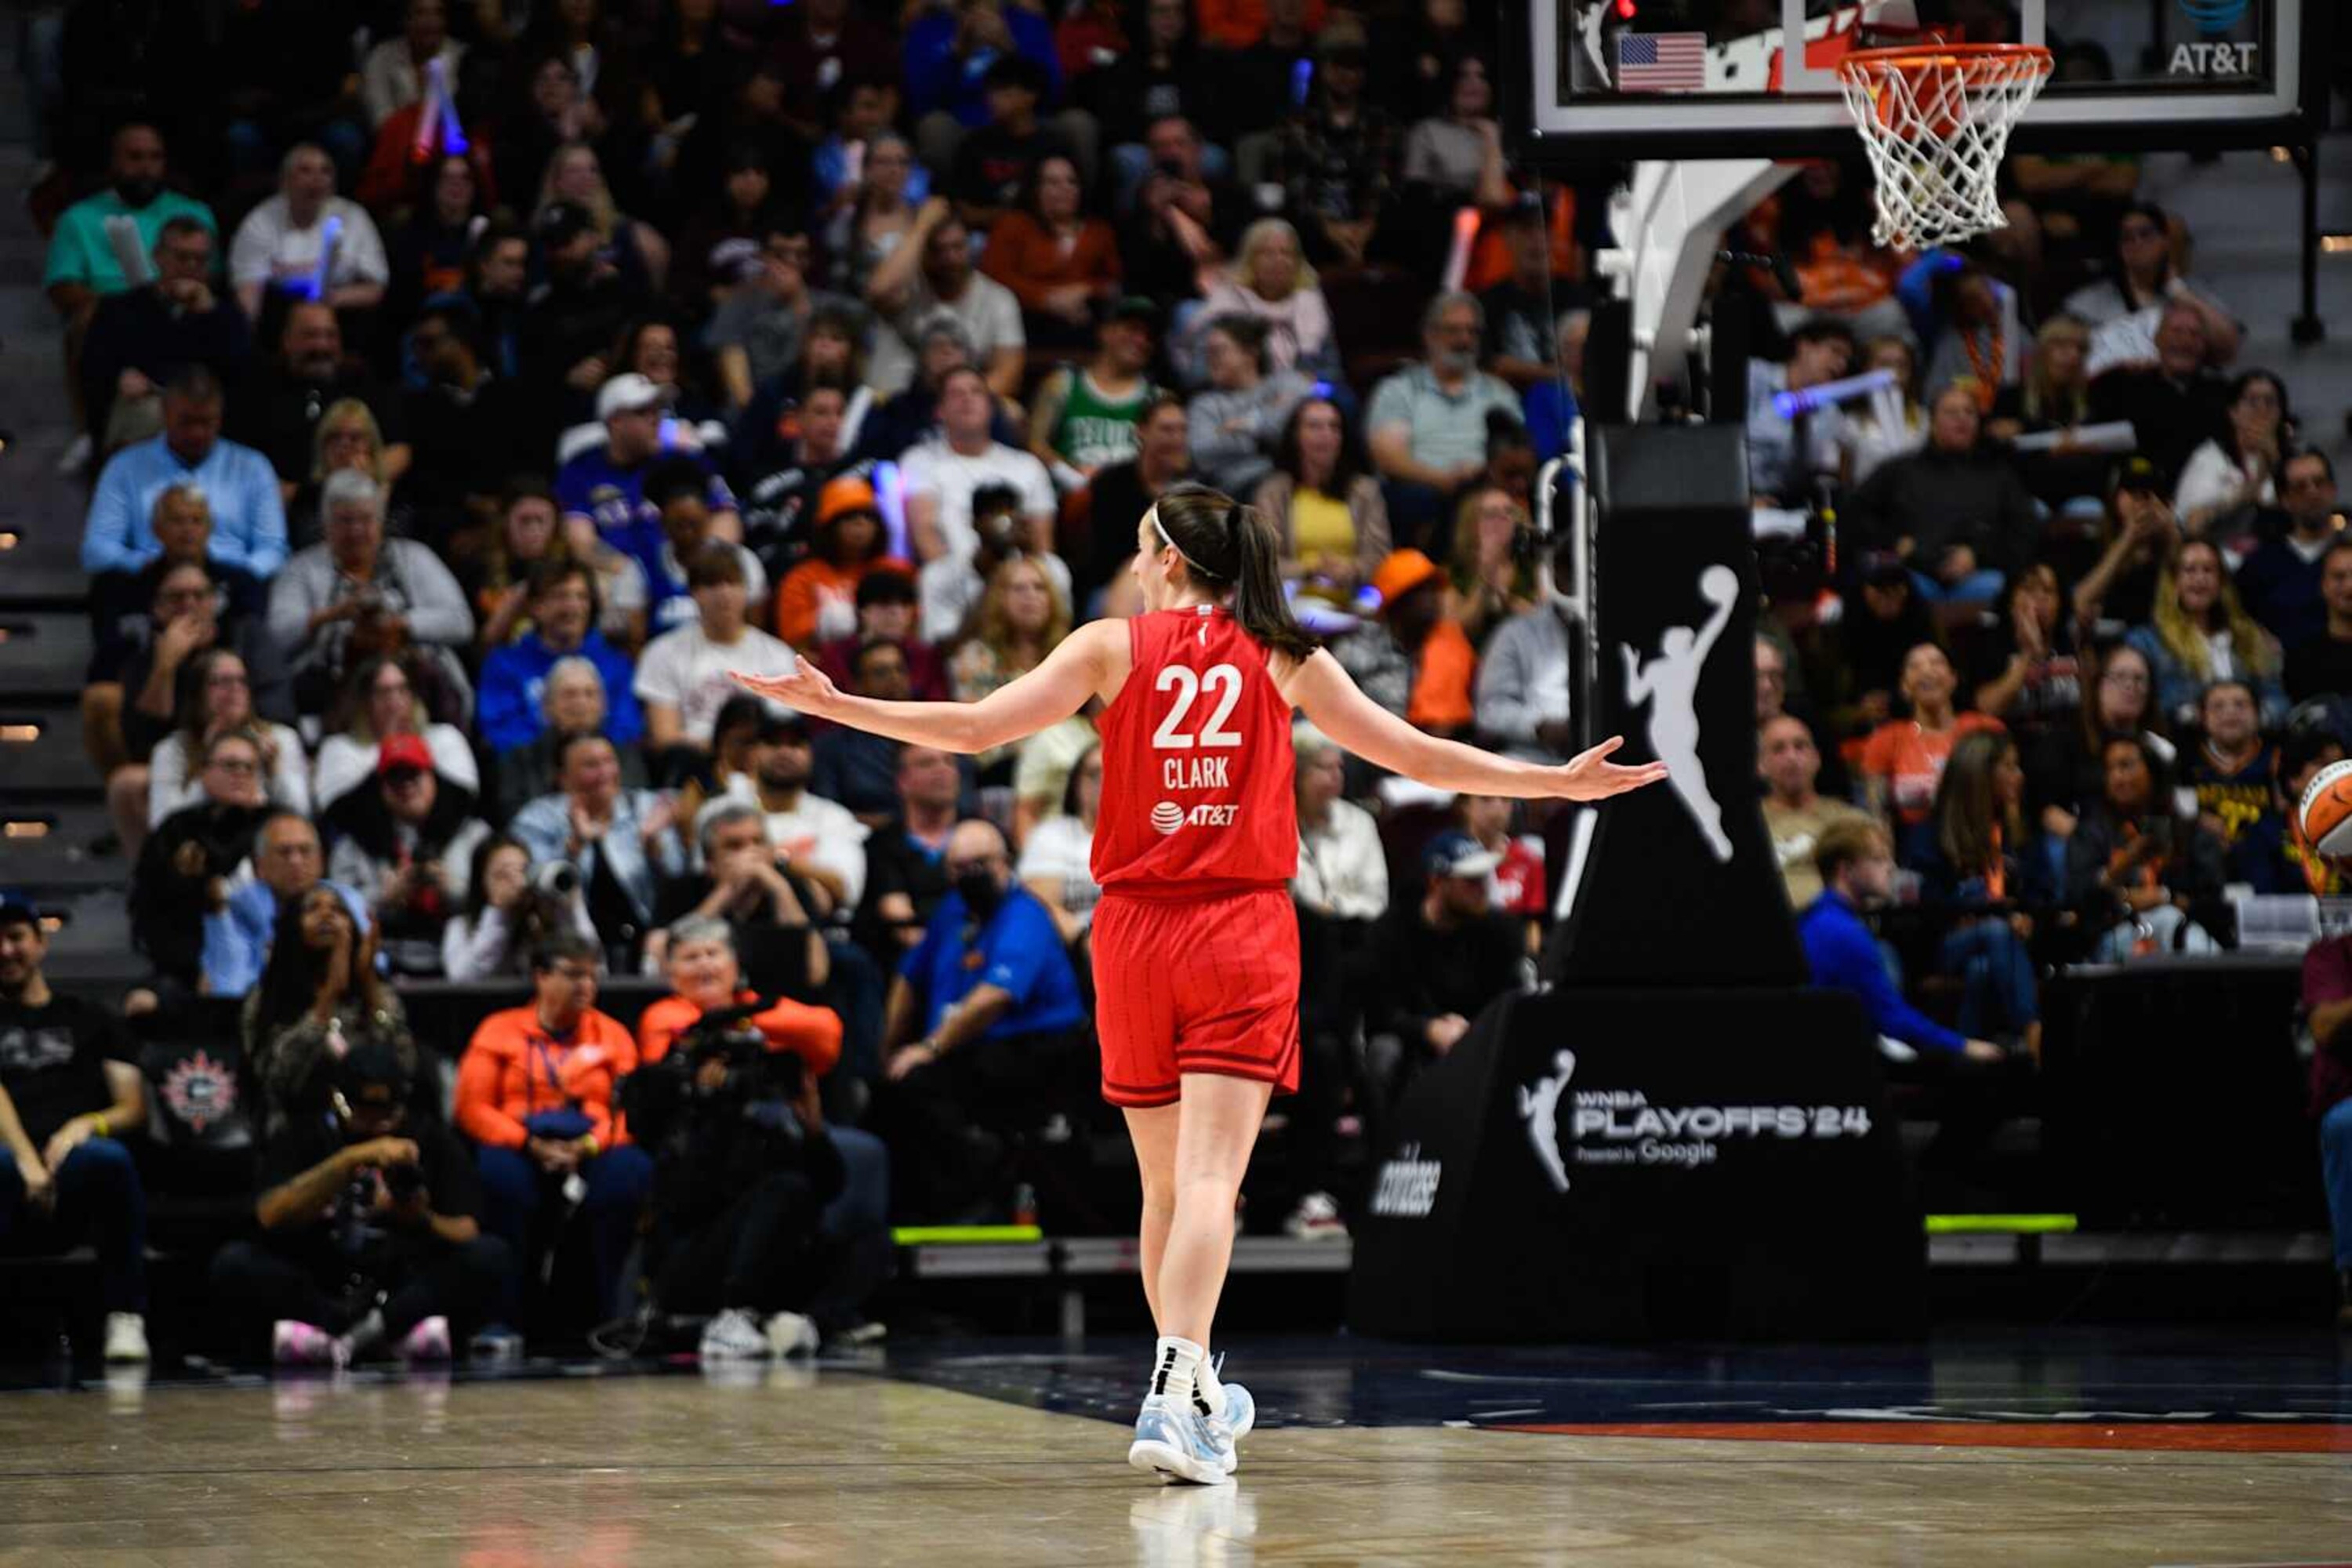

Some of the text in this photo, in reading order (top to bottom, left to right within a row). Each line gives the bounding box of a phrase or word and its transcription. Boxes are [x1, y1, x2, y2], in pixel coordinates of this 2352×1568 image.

[2169, 42, 2258, 74] AT&T
[1152, 664, 1243, 748] 22
[1163, 756, 1229, 789] CLARK
[1184, 804, 1240, 826] AT&T
[1576, 1091, 1647, 1107] WNBA
[1641, 1138, 1718, 1167] Google
